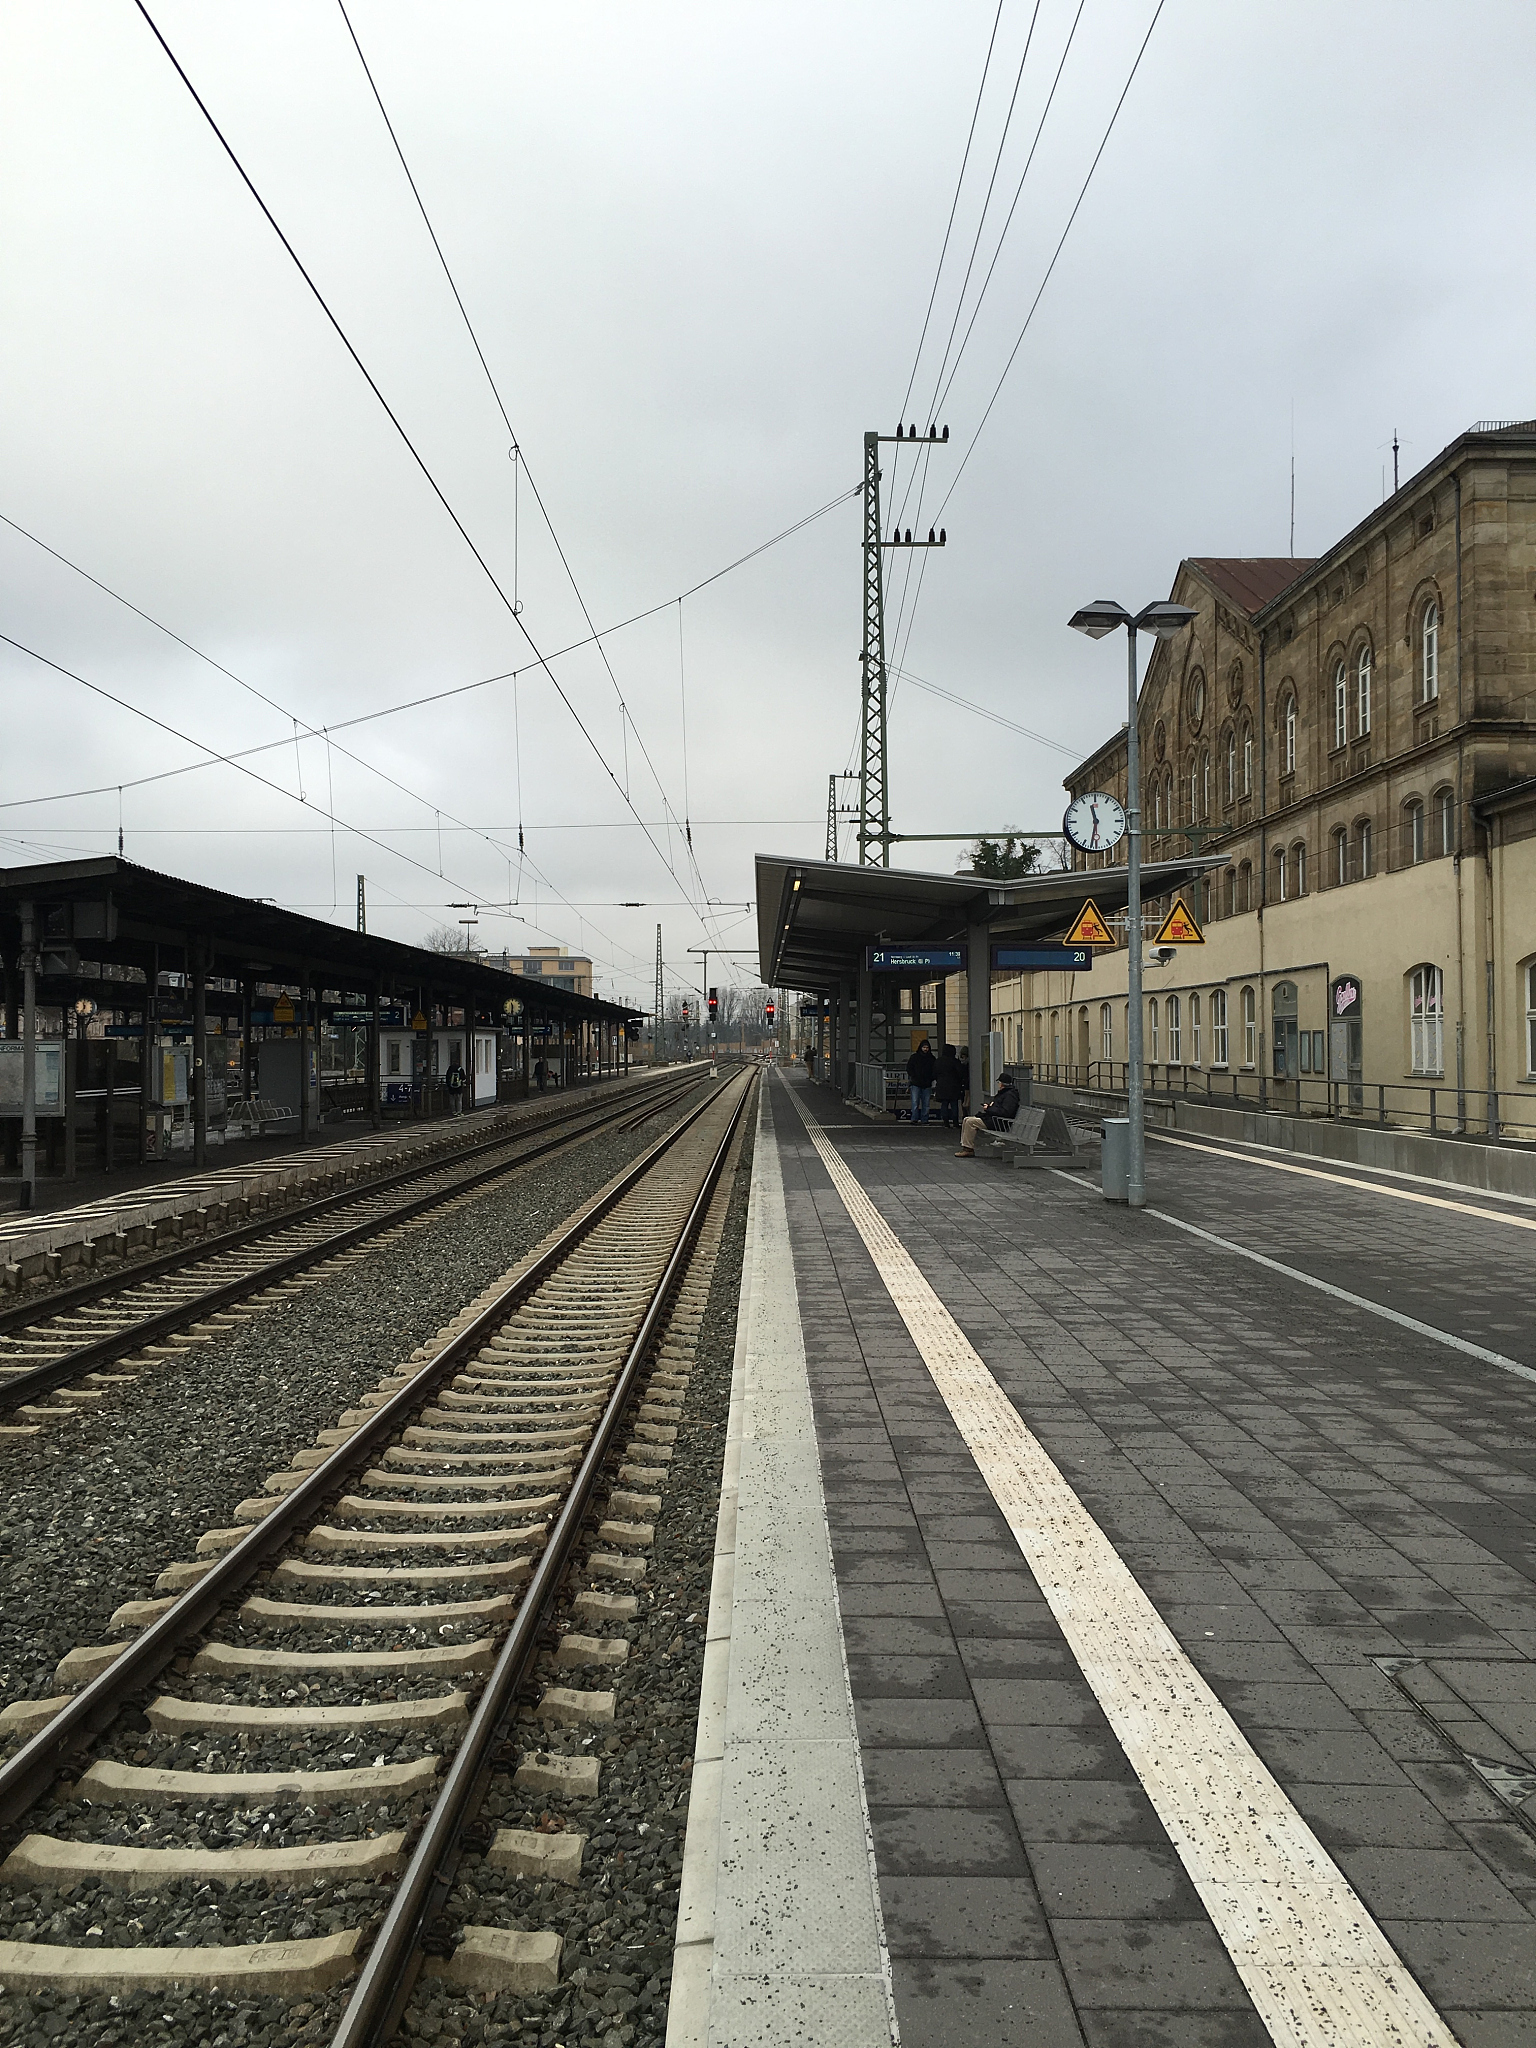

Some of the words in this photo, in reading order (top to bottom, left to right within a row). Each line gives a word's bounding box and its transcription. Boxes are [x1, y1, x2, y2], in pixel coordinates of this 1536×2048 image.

[873, 952, 885, 962] 21
[1073, 951, 1086, 962] 20
[394, 1010, 400, 1019] 2
